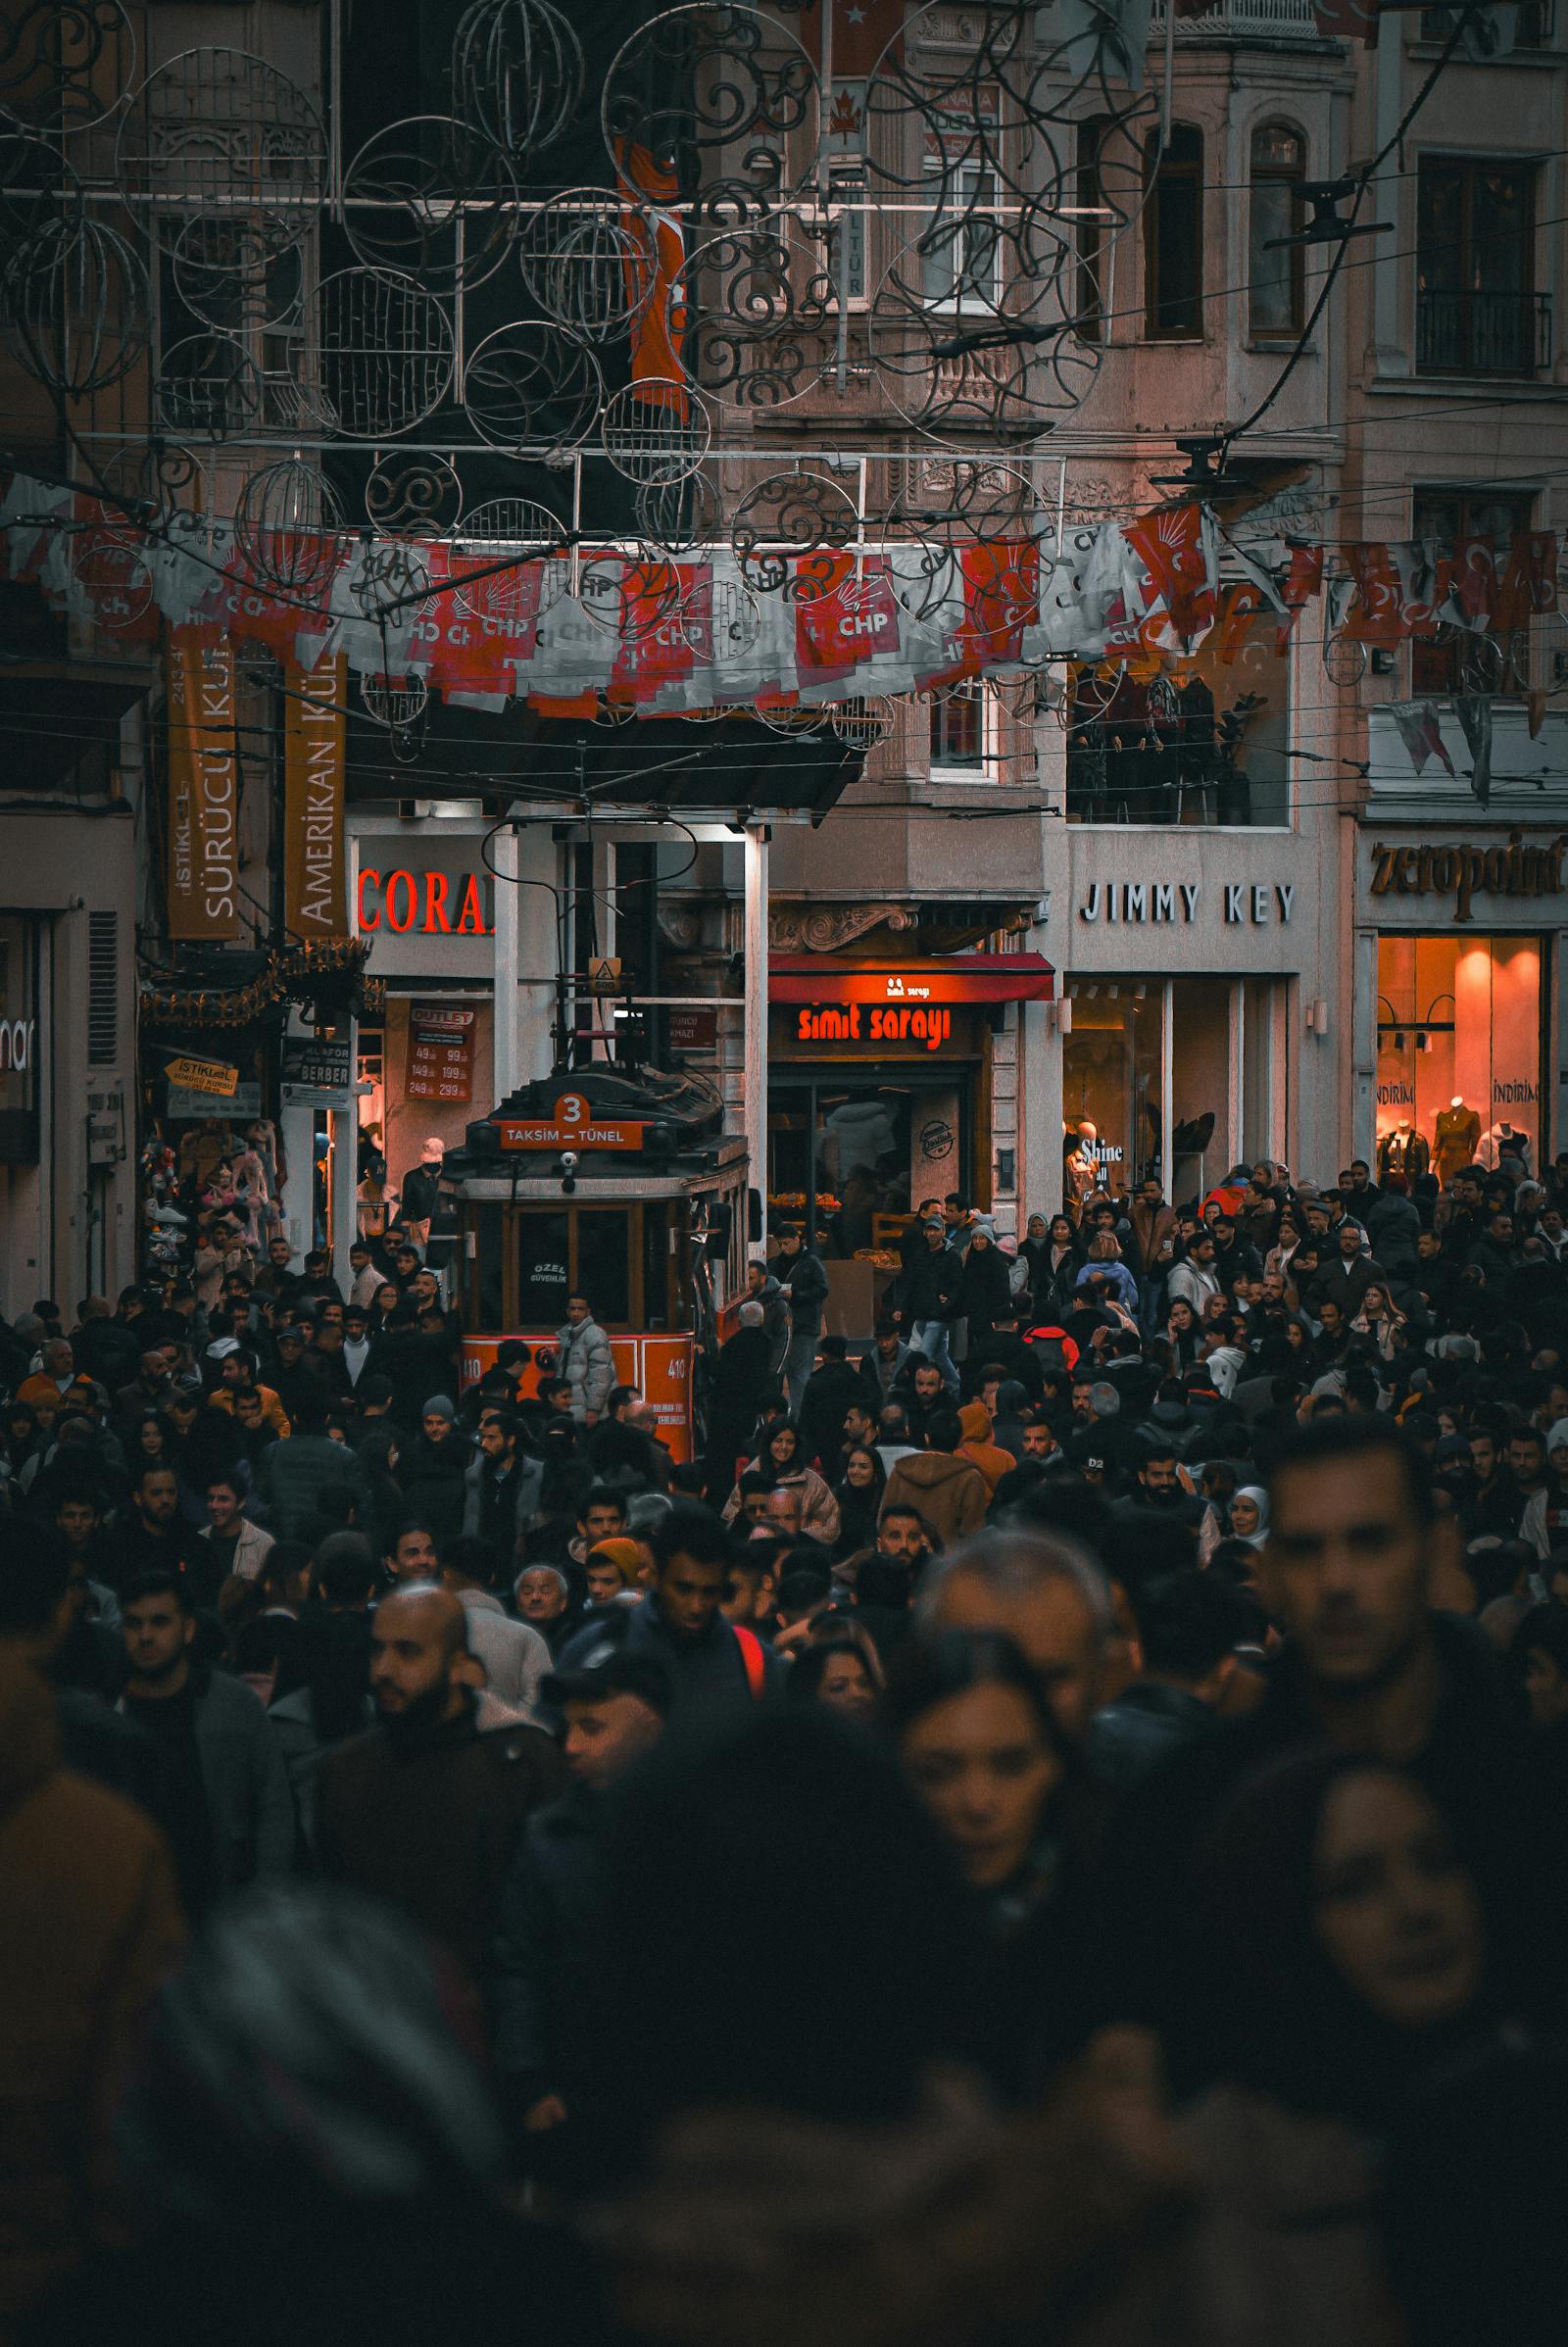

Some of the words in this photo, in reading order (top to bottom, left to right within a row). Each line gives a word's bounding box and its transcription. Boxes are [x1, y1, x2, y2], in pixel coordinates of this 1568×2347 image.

[482, 619, 528, 639] CHP
[655, 625, 703, 646] CHP
[839, 613, 888, 637] CHP
[198, 748, 233, 918] SÜRÜCÜ
[300, 741, 336, 925] AMERİKAN
[359, 868, 495, 934] CORA
[1080, 884, 1200, 922] JIMMY
[1225, 885, 1295, 922] KEY
[414, 1008, 472, 1025] OUTLET
[799, 1002, 860, 1040] simit
[870, 1009, 950, 1050] sarayı
[302, 1065, 349, 1083] BERBER
[562, 1097, 581, 1122] 3
[507, 1129, 560, 1142] TAKSİM
[578, 1129, 624, 1143] TÜNEL
[1081, 1139, 1123, 1164] Shine
